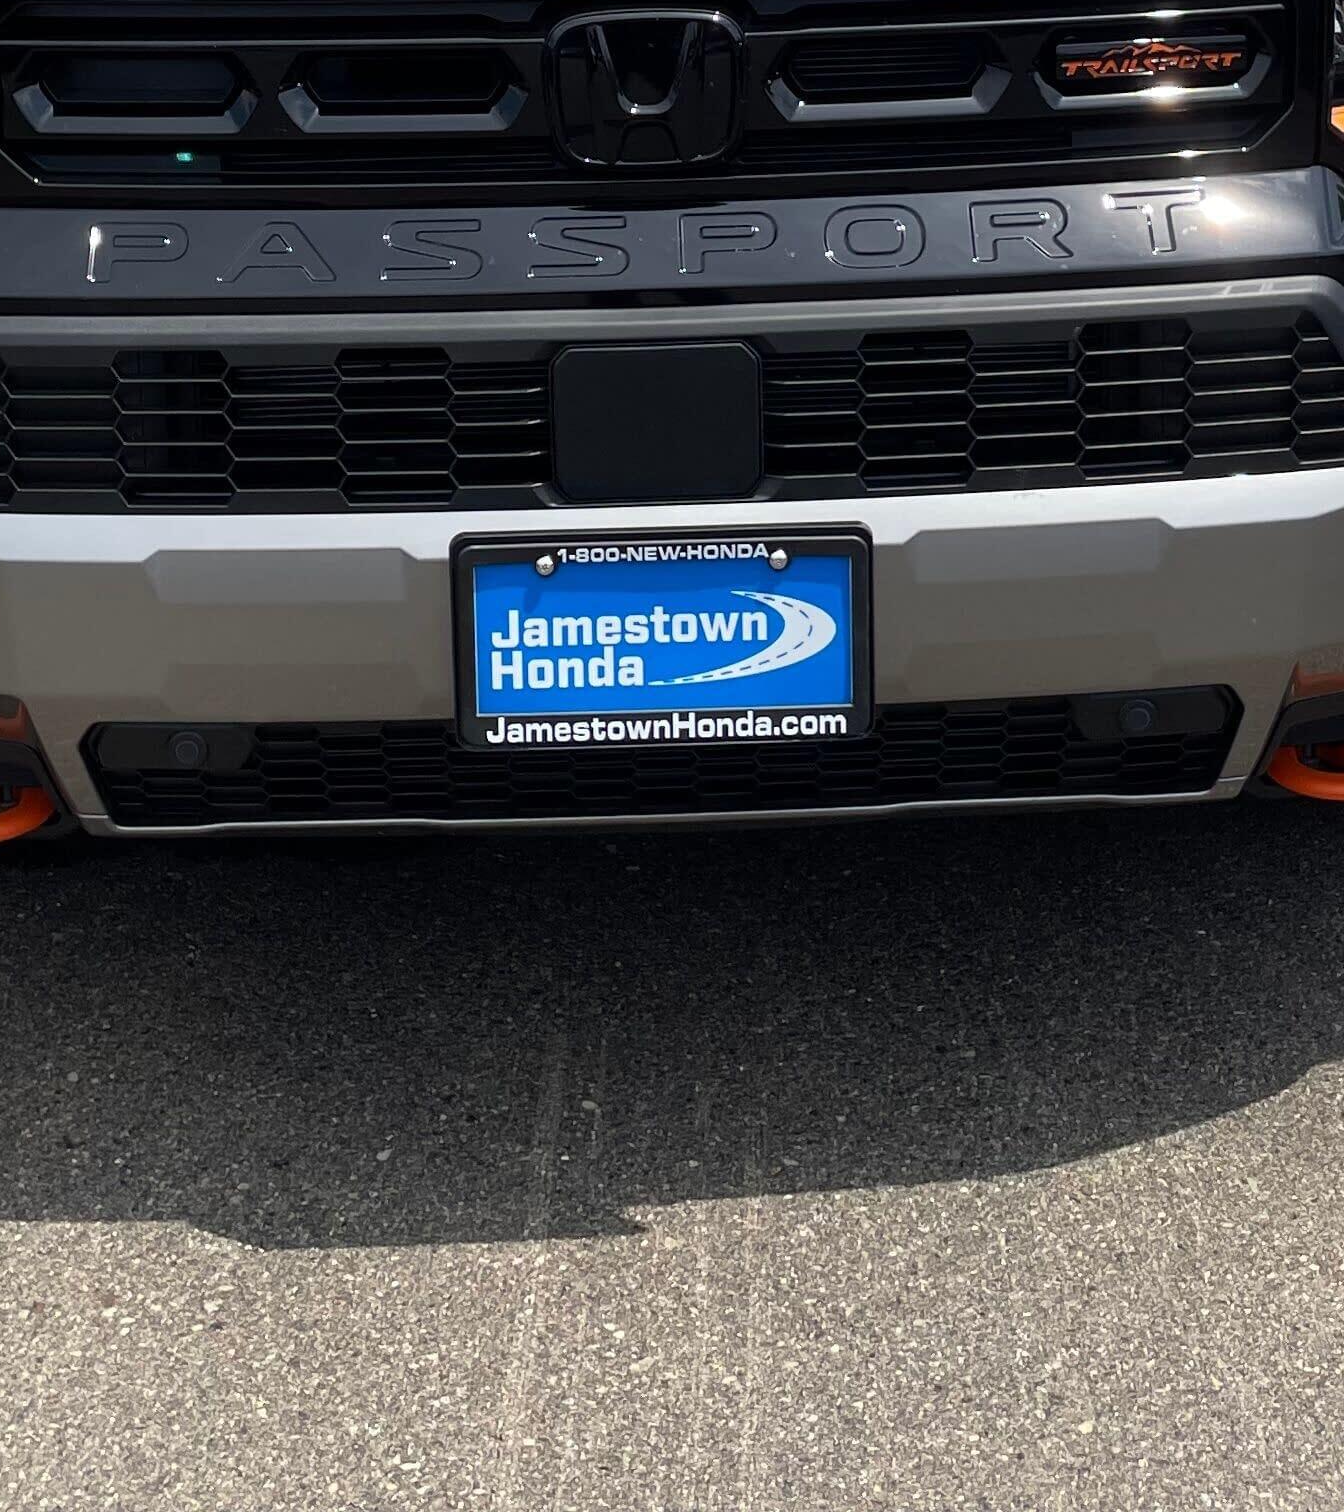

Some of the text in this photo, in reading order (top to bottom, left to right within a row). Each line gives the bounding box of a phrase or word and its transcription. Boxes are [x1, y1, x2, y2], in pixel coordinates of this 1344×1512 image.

[1060, 51, 1242, 78] TRAILSPORT
[87, 188, 1205, 285] PASSPORT
[556, 543, 769, 564] 1-800-NEW-HONDA
[491, 606, 768, 649] Jamestown
[491, 645, 645, 690] Honda
[486, 710, 847, 744] JamestownHonda.com
